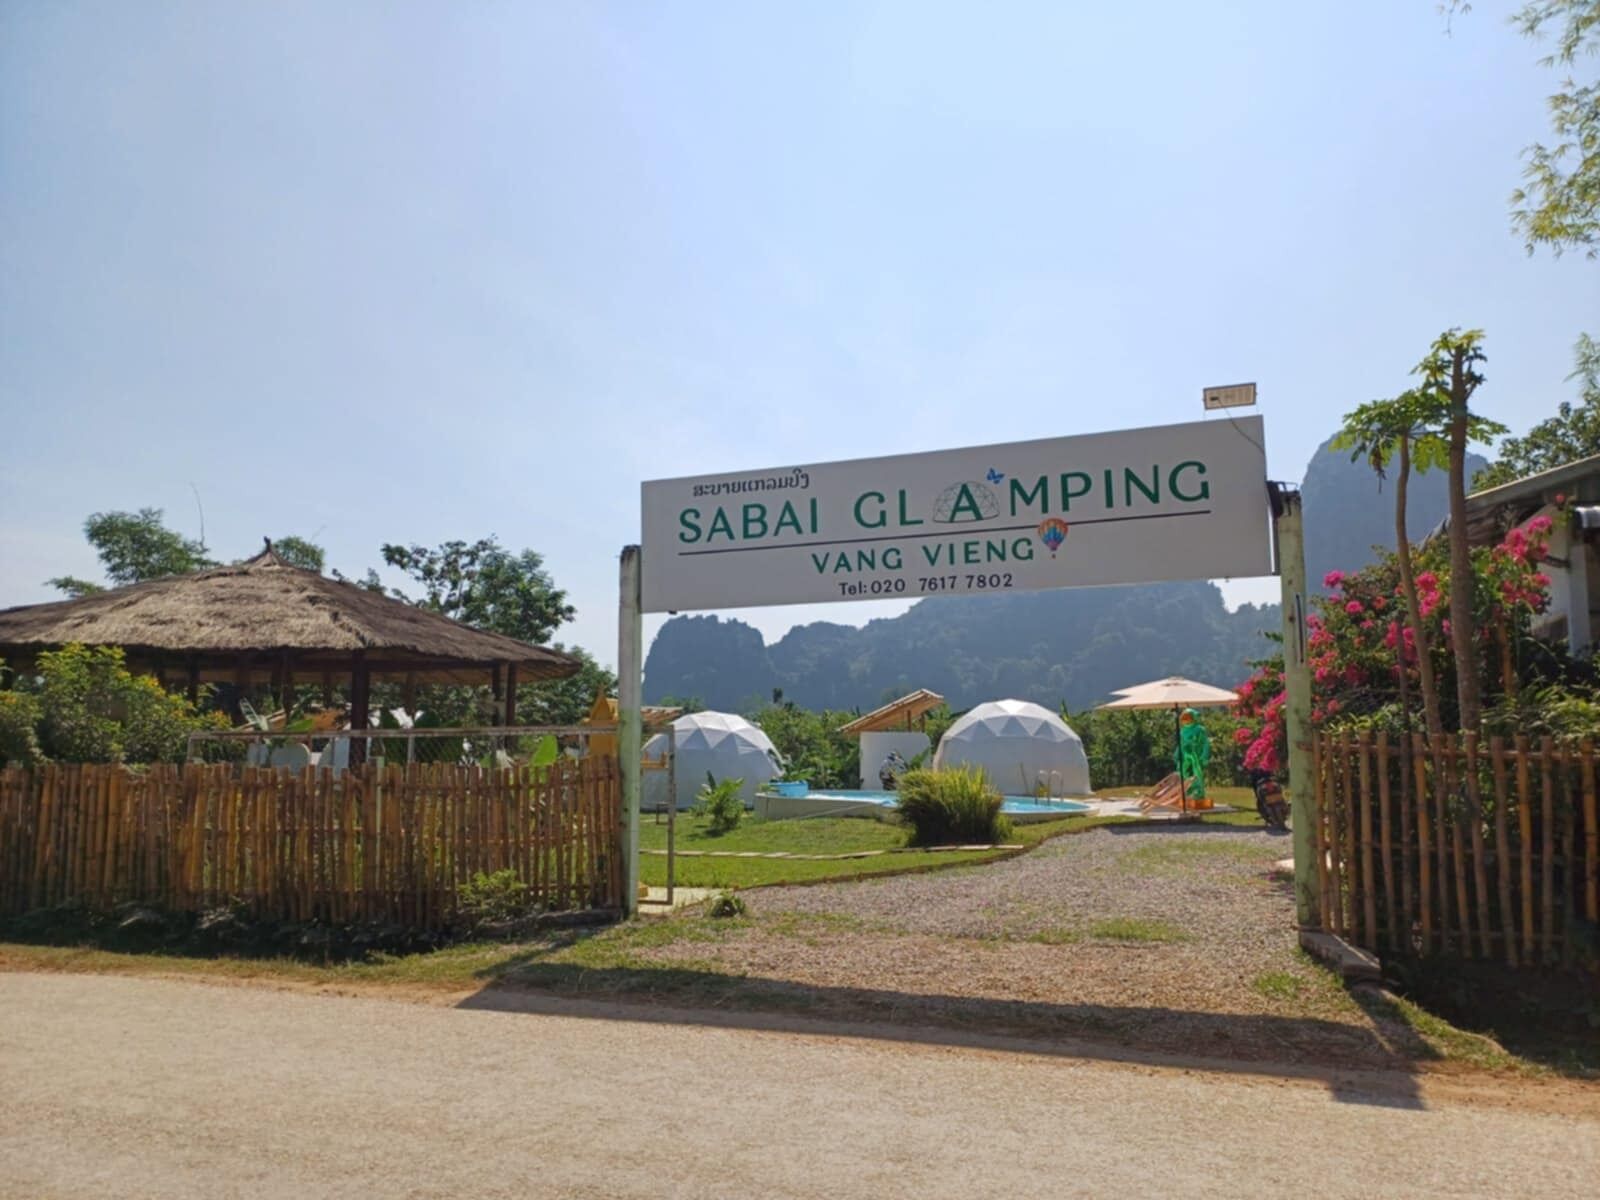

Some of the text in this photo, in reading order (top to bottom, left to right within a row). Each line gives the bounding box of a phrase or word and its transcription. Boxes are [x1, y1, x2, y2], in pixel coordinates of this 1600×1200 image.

[678, 460, 1210, 544] SABAI GLAMPING
[811, 537, 1034, 575] VANG VIENG
[918, 575, 959, 592] 7617
[965, 573, 1013, 589] 7802
